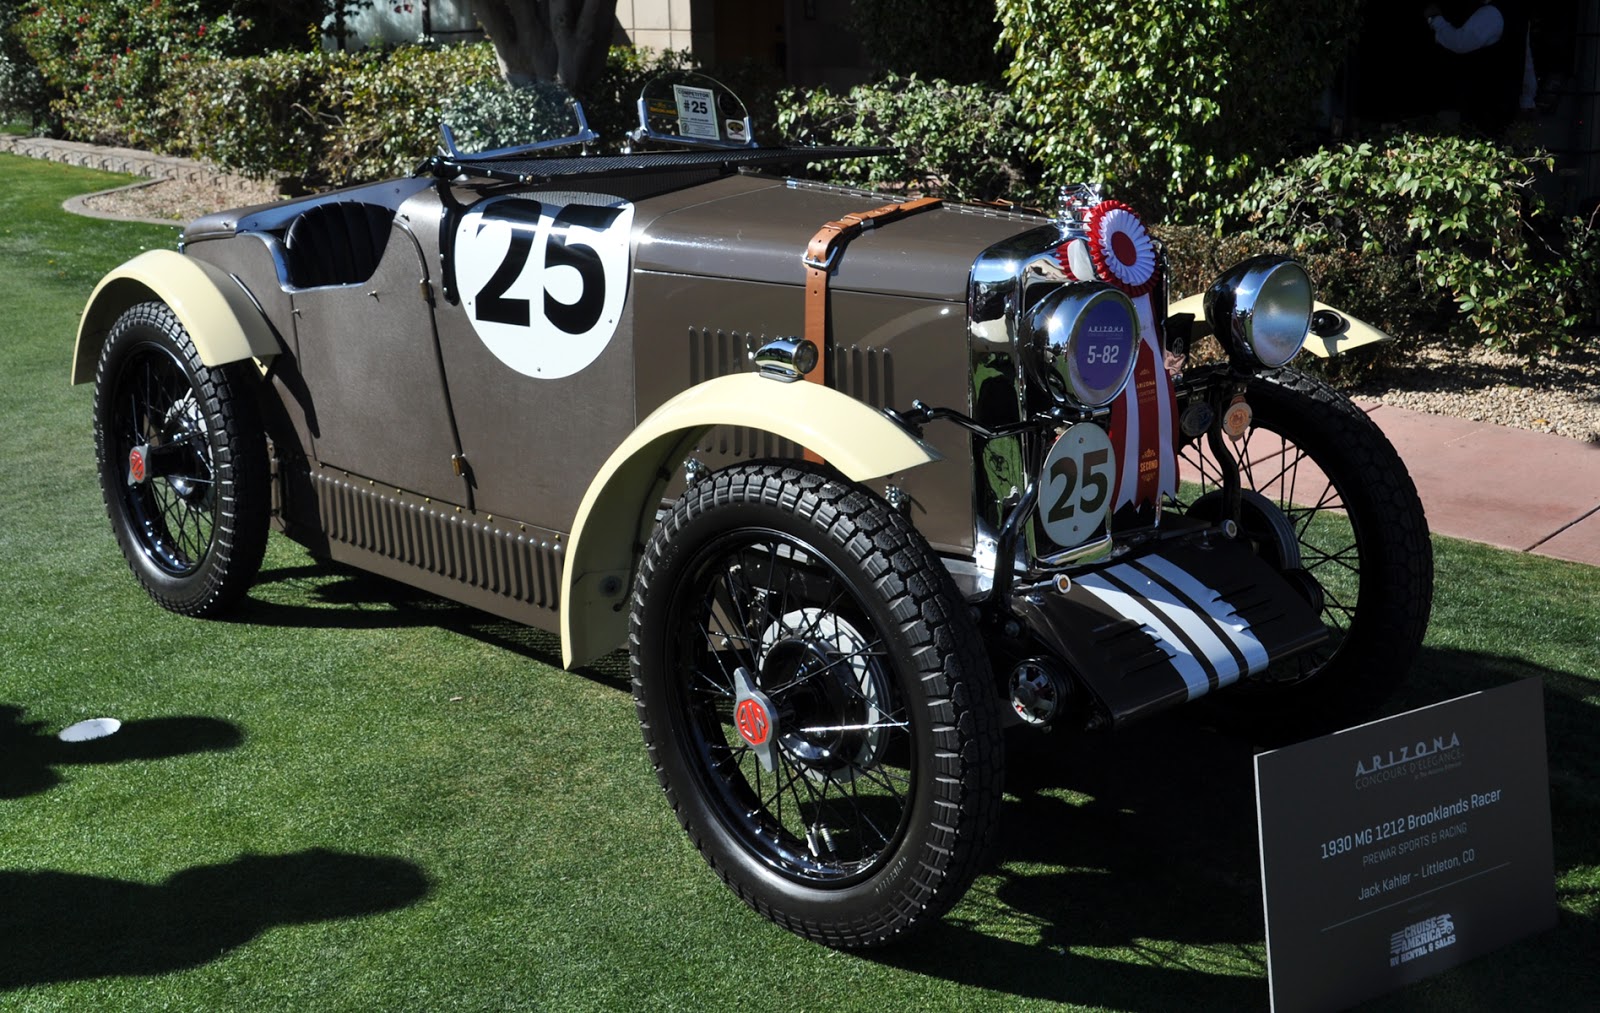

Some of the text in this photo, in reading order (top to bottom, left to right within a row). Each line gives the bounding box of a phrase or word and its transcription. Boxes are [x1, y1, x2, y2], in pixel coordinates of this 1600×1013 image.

[683, 100, 708, 114] #25
[475, 199, 627, 335] 25
[1088, 325, 1124, 333] ARIZONA
[1087, 343, 1120, 364] 5-82
[1139, 457, 1159, 473] SECOND
[1047, 448, 1109, 524] 25
[1355, 731, 1460, 777] ARIZONA
[1355, 766, 1407, 790] CONCOURS
[1320, 789, 1502, 860] 1930 MG 1212 Brooklands Racer
[1362, 822, 1468, 867] PREWAR SPORTS & RACING
[1358, 882, 1381, 901] Jack
[1382, 872, 1411, 893] Kahler
[1421, 855, 1461, 878] Littleton,
[1462, 848, 1475, 864] CO
[1401, 927, 1442, 953] AMERICA
[1404, 916, 1437, 939] CRUISE
[1389, 955, 1400, 968] RV
[1400, 945, 1428, 963] RENTAL
[1434, 933, 1457, 950] SALES
